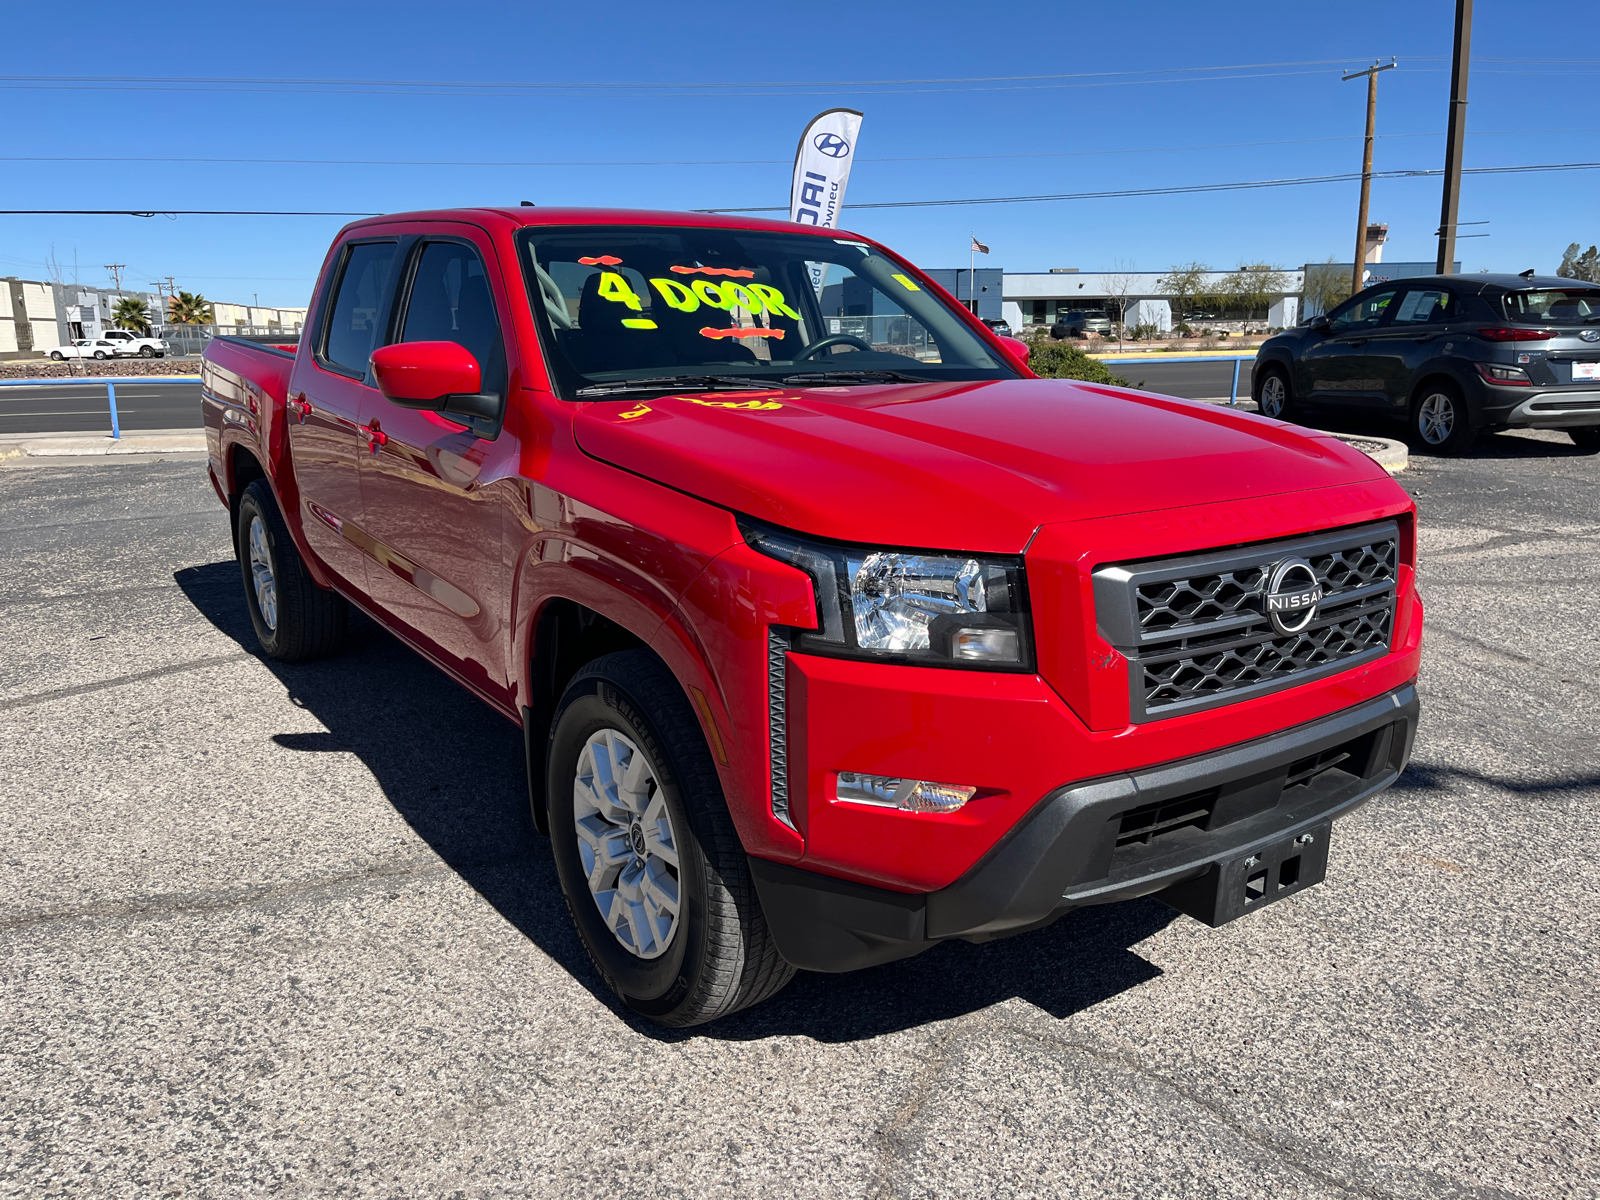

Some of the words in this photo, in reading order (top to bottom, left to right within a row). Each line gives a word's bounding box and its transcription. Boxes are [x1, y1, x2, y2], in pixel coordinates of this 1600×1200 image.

[598, 272, 642, 311] 4
[649, 278, 804, 320] DOOR
[1141, 489, 1378, 536] FRONTIER
[1269, 589, 1323, 610] NISSAN
[618, 700, 672, 782] MICHELIN
